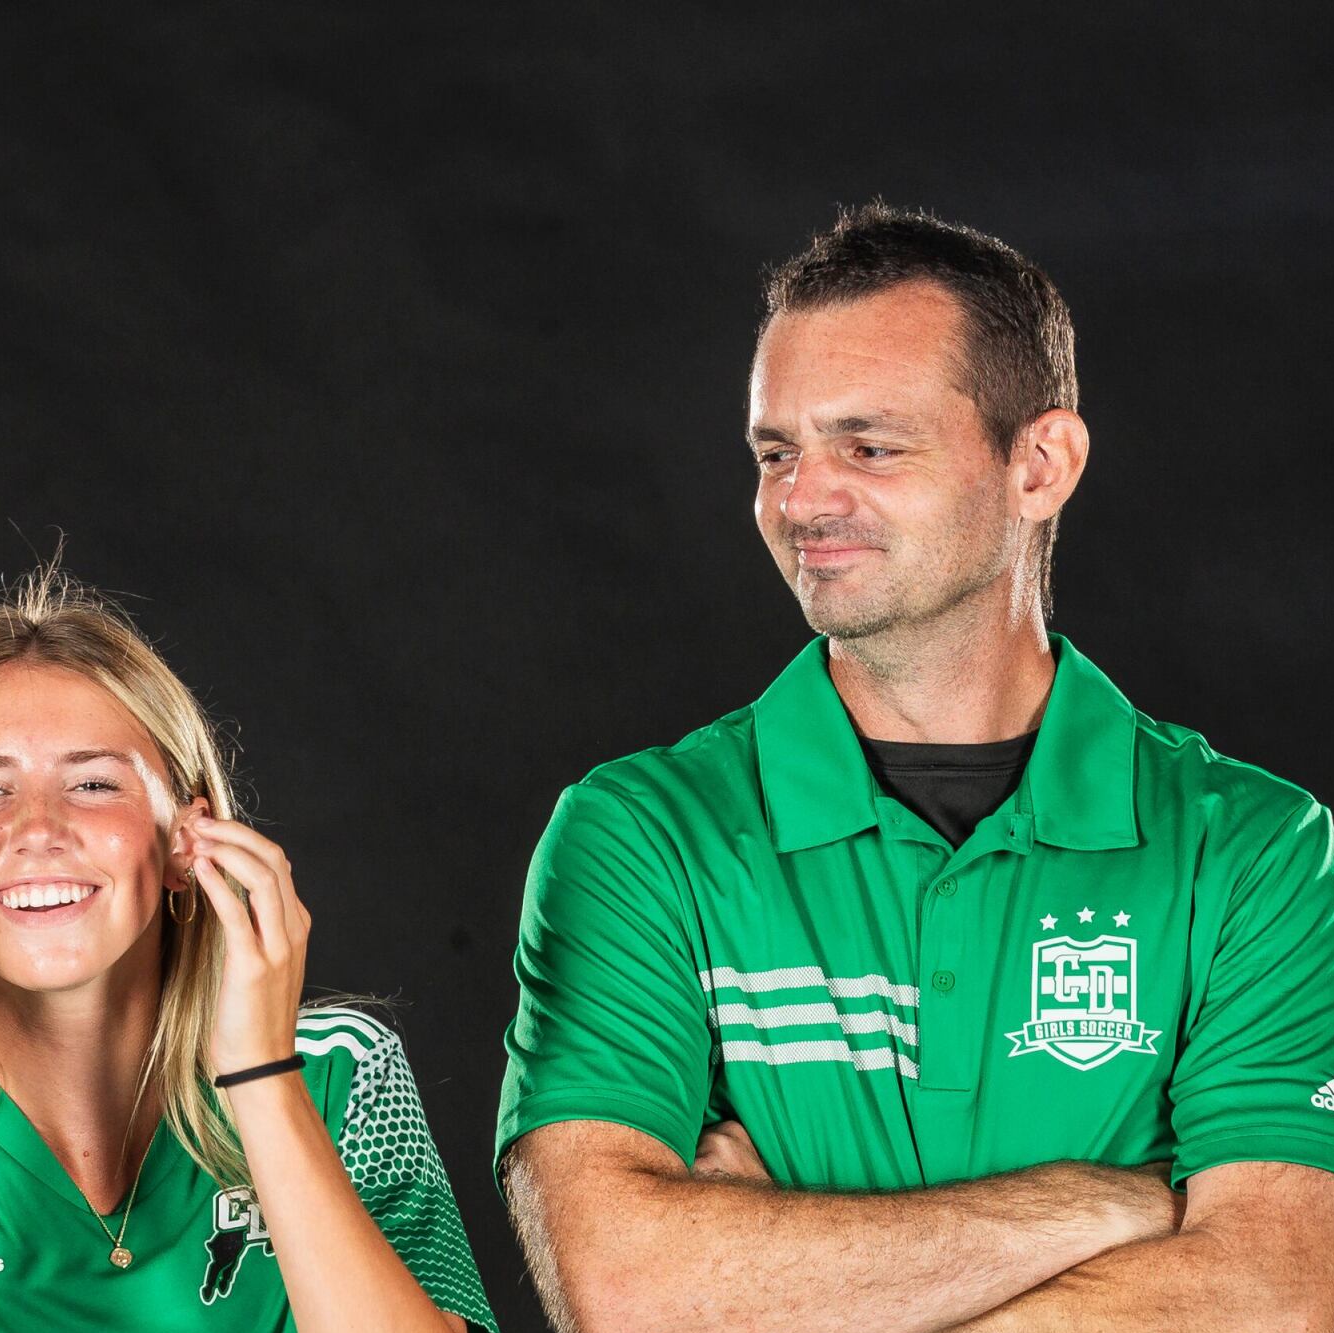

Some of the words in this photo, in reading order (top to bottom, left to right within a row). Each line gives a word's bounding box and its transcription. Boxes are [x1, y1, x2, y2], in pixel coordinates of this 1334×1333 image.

[1054, 954, 1115, 1015] CD
[1034, 1021, 1075, 1039] GIRLS
[1079, 1020, 1133, 1040] SOCCER
